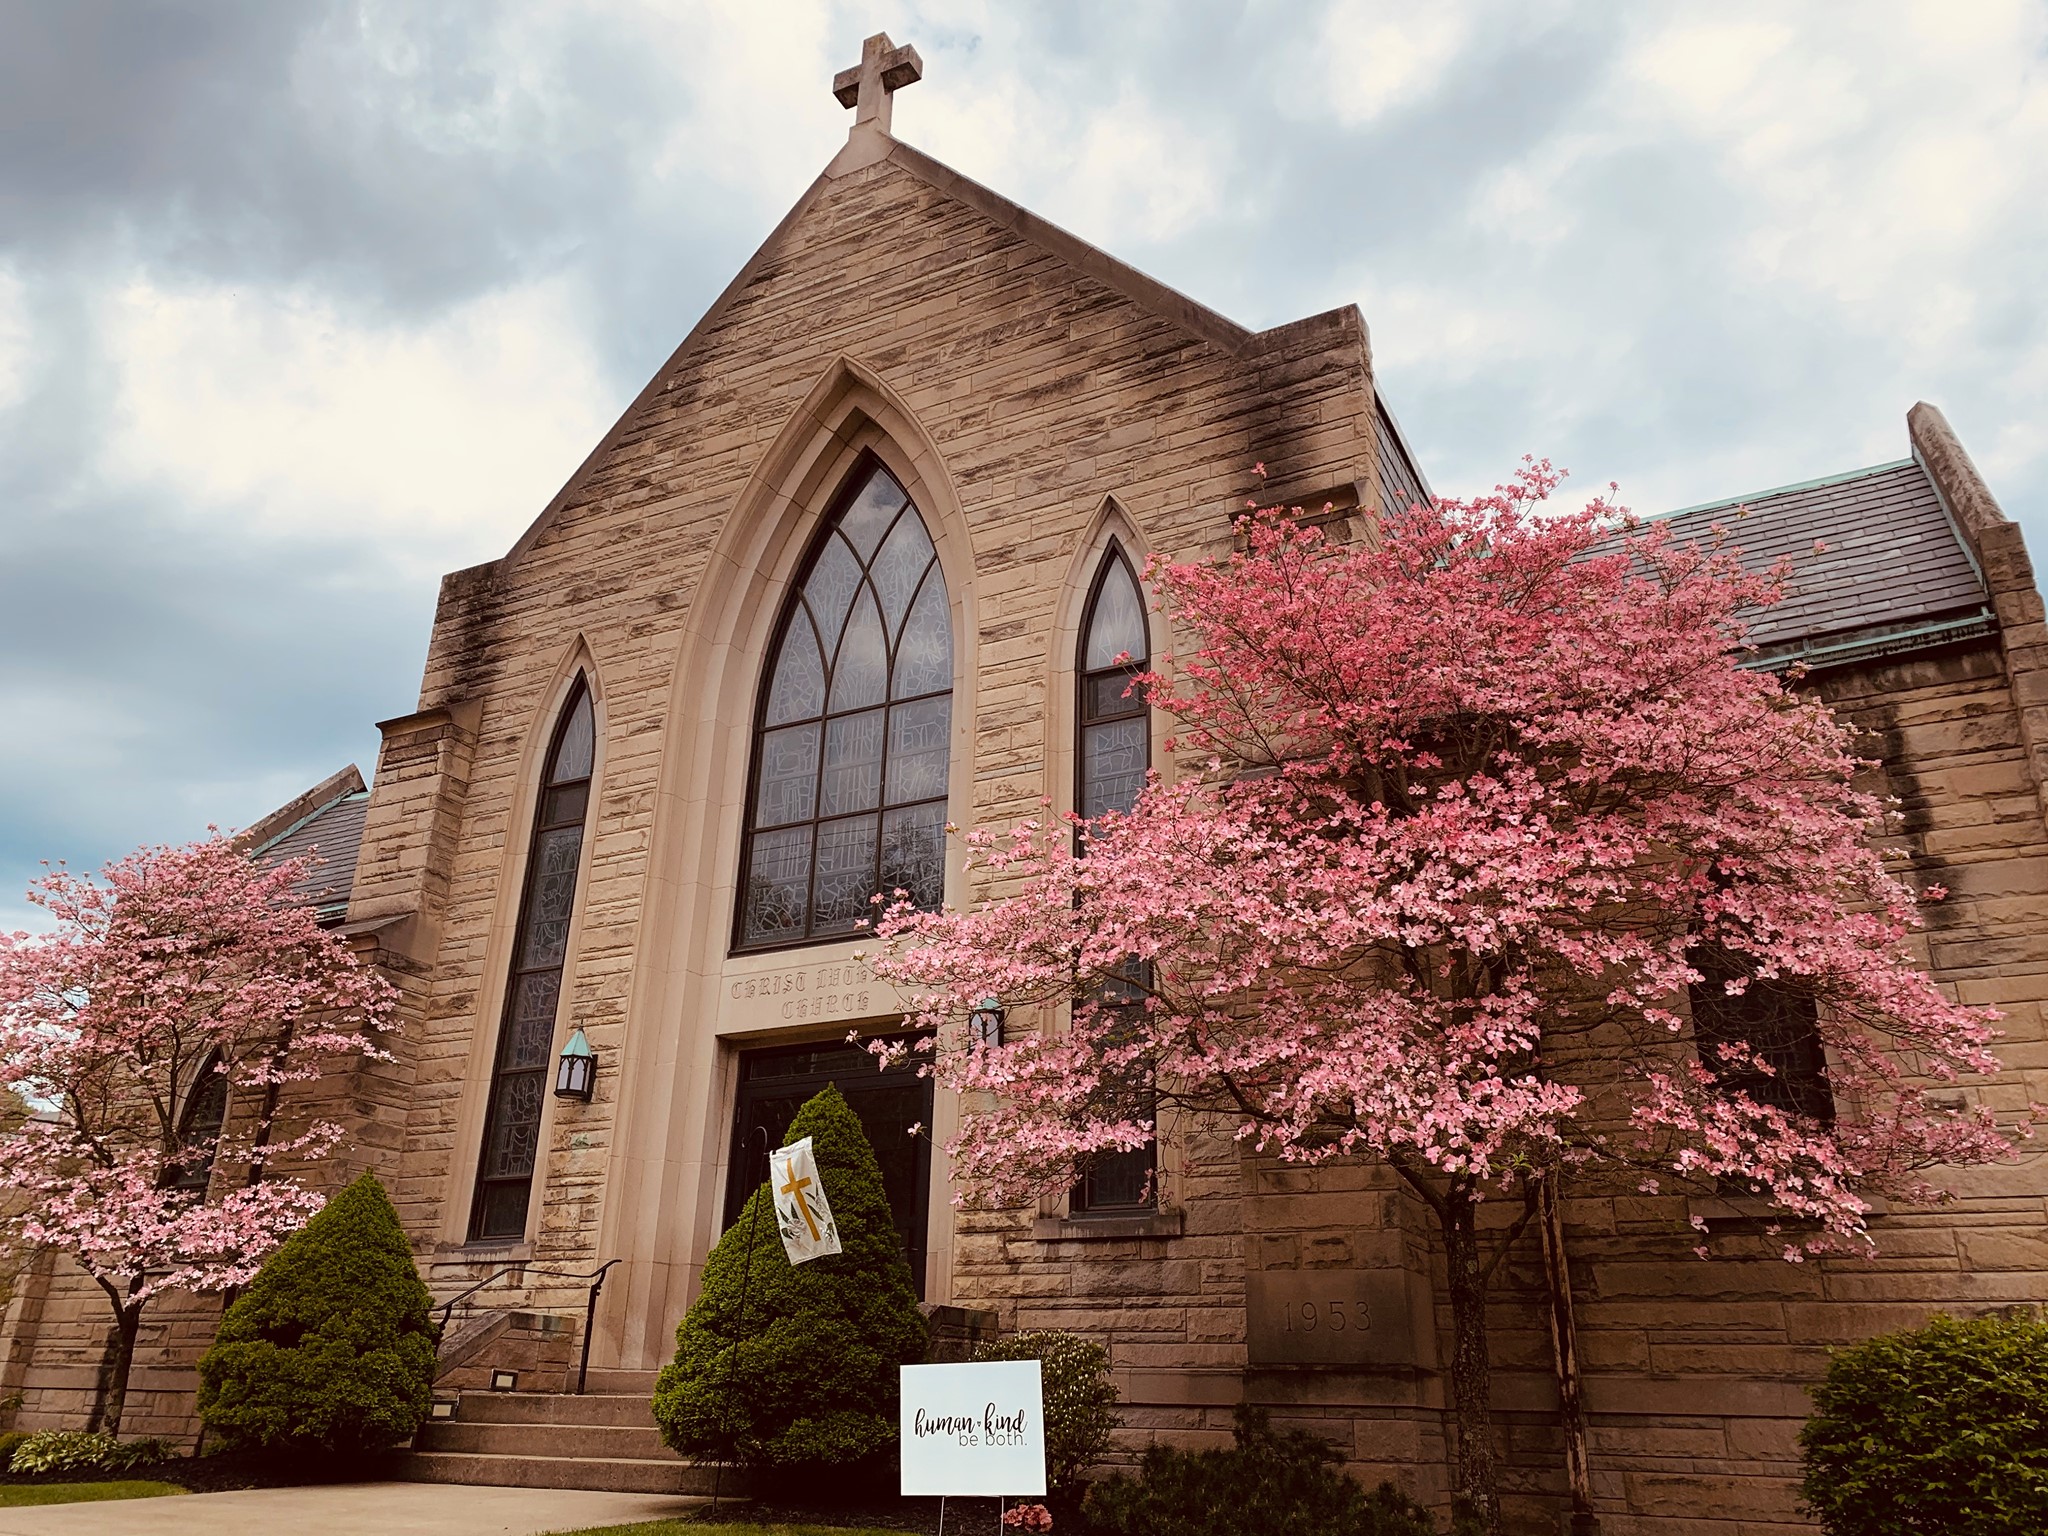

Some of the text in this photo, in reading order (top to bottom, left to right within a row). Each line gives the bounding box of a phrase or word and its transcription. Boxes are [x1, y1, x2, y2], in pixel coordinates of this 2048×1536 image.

[731, 972, 807, 1000] CHRIST
[781, 990, 869, 1020] CHURCH
[1282, 1301, 1372, 1332] 1953
[914, 1402, 1028, 1438] human kind
[958, 1430, 1028, 1447] be both.
